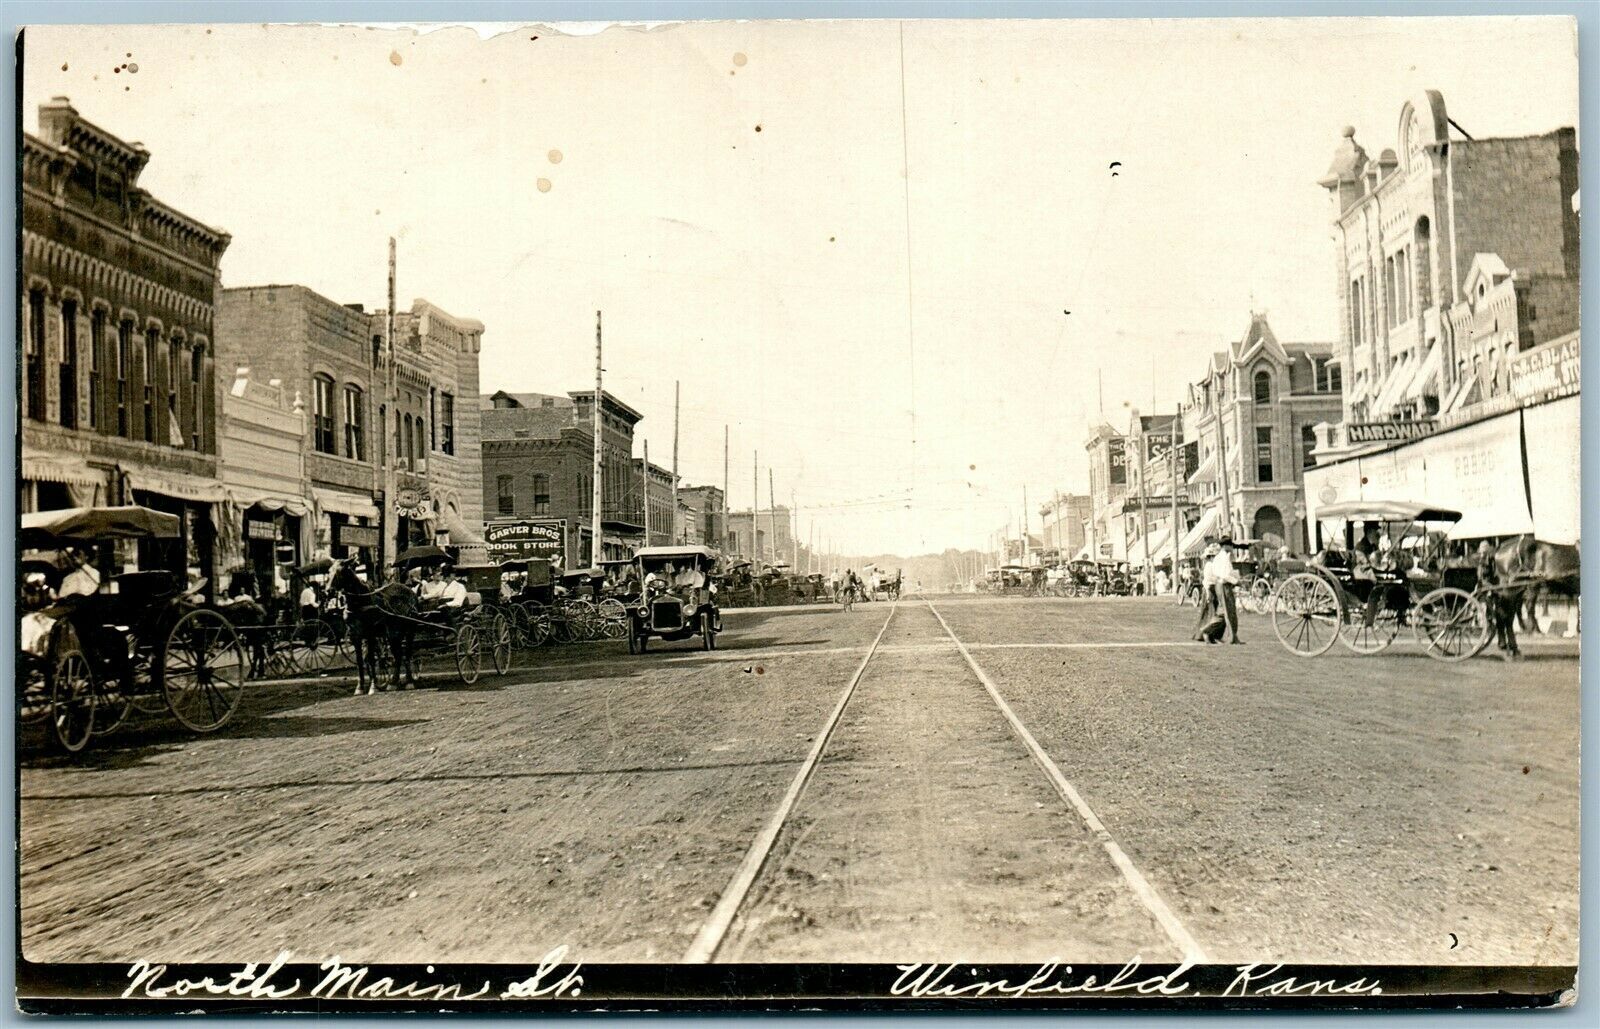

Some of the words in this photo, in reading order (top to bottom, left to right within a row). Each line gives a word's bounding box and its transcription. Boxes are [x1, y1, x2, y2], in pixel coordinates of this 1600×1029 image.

[1150, 435, 1169, 443] THE
[489, 526, 529, 541] GARVER
[531, 526, 561, 542] BROS.
[523, 541, 565, 550] STORE.
